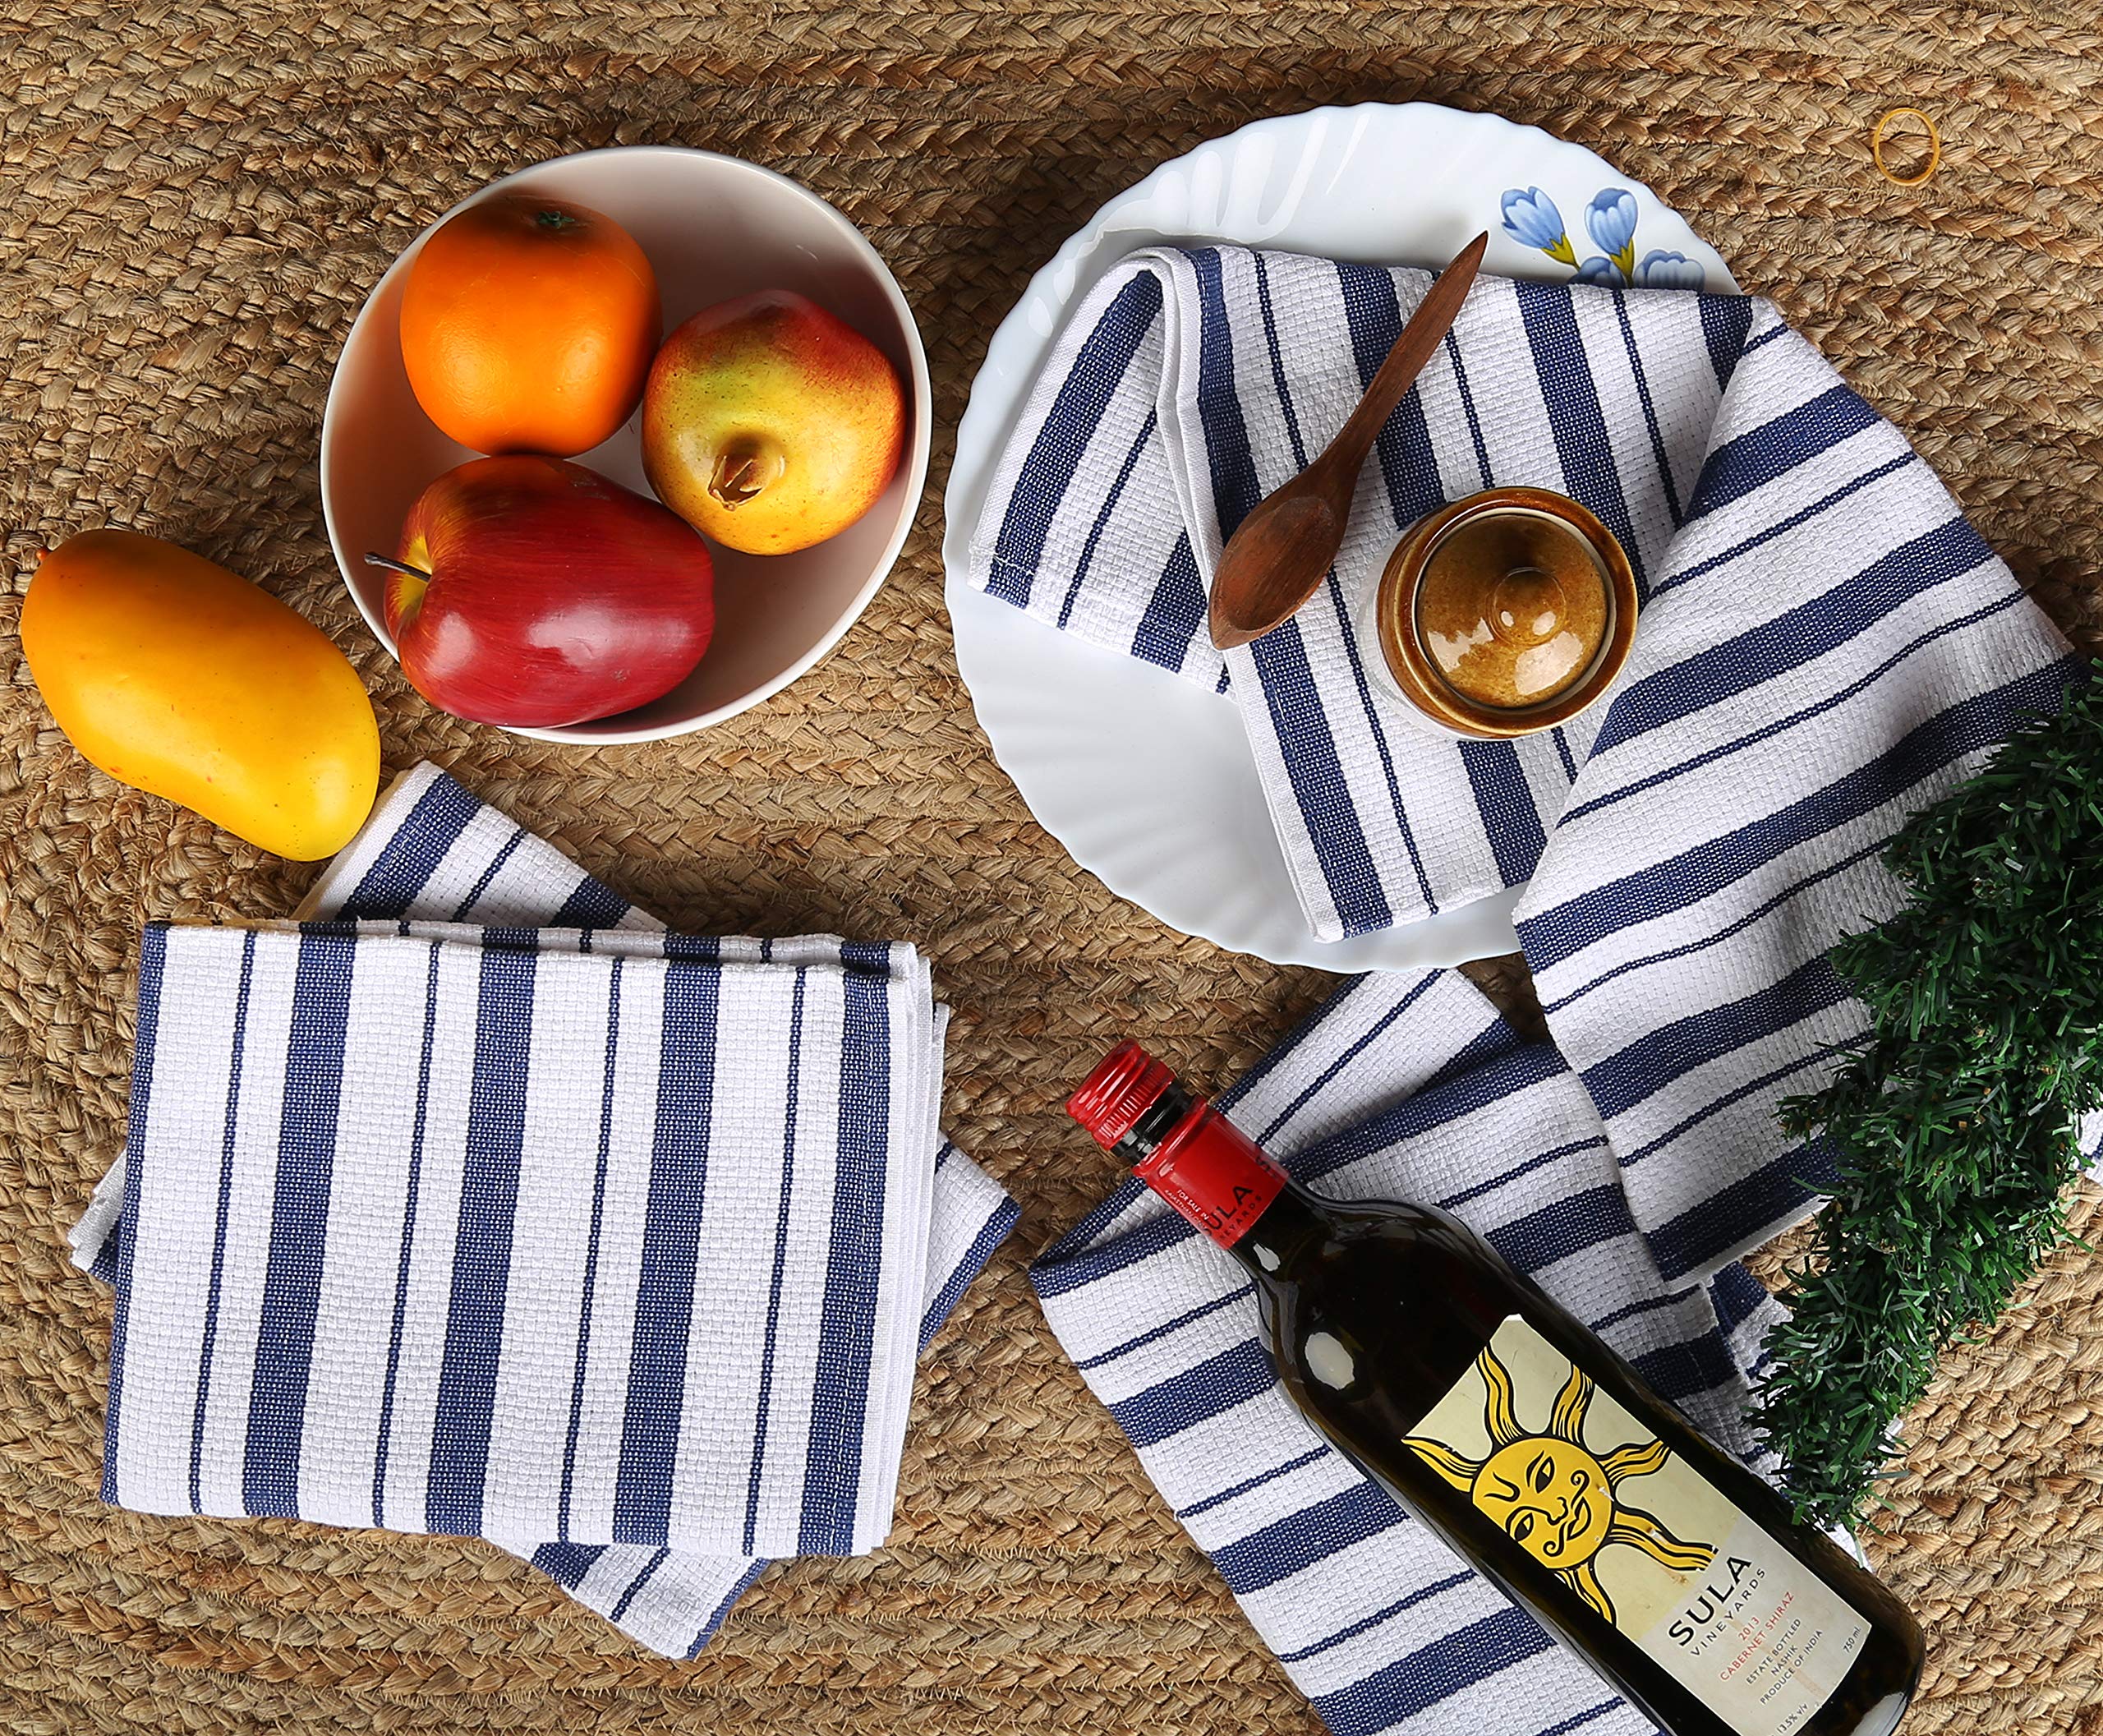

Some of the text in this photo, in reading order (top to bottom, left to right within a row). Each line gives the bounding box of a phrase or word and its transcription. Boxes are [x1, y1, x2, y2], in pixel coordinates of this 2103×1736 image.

[1176, 1190, 1210, 1221] FOR SALE IN
[1668, 1556, 1752, 1647] SULA
[1691, 1568, 1765, 1656] VINEYARDS
[1719, 1591, 1794, 1681] CABERNET SHIRAZ
[1738, 1616, 1761, 1642] 2013
[1746, 1619, 1802, 1684] ESTATE BOTTLED
[1843, 1637, 1856, 1653] 750
[1760, 1630, 1823, 1705] PRODUCE OF INDIA
[1770, 1645, 1798, 1676] NASHIK
[1776, 1702, 1809, 1734] 13.5% v/v
